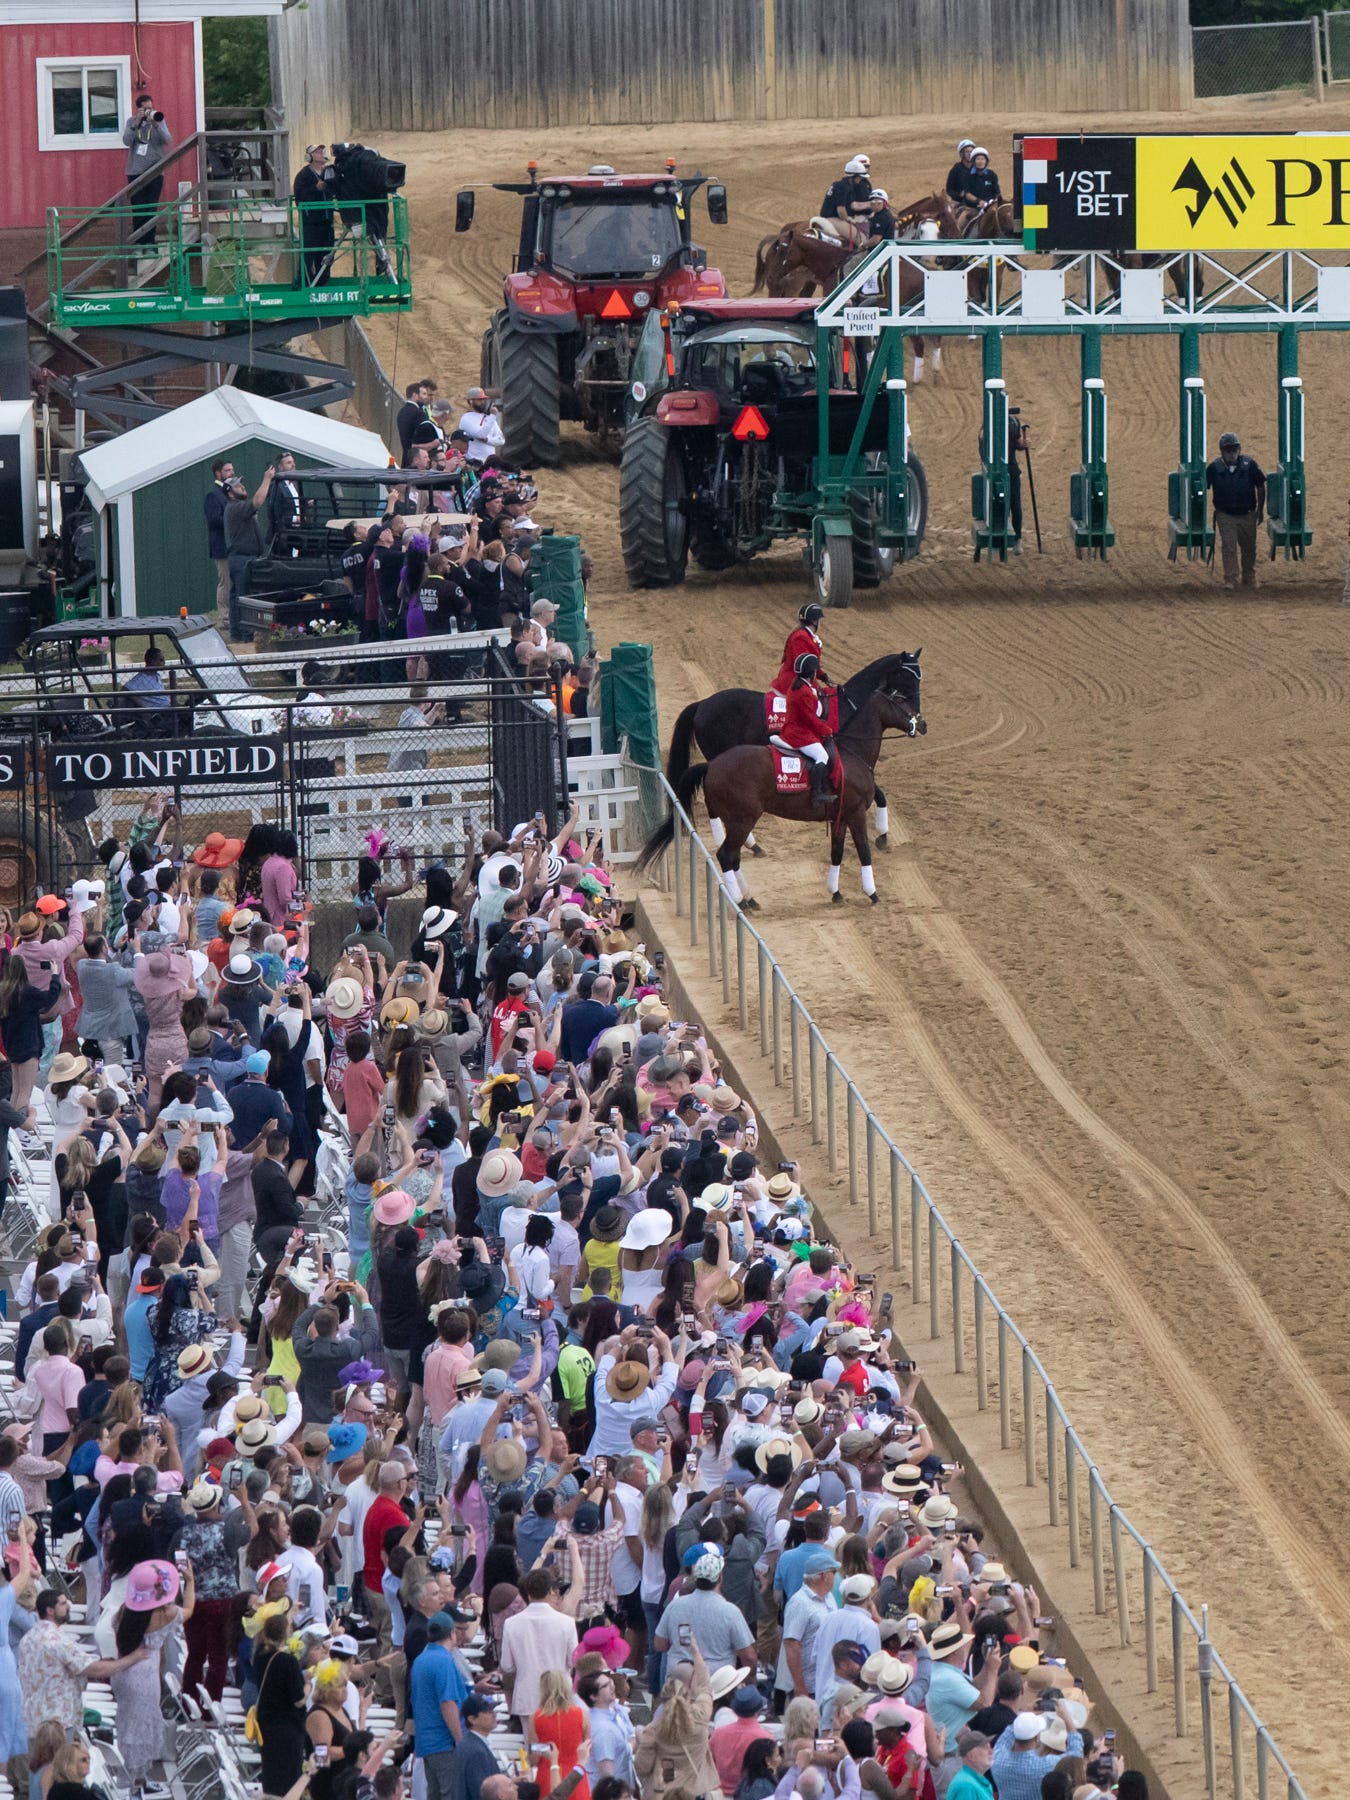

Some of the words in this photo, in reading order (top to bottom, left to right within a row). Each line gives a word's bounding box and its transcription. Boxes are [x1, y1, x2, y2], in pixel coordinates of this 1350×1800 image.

[1055, 170, 1112, 194] 1/ST
[1077, 193, 1129, 216] BET
[653, 255, 659, 266] 2
[346, 290, 360, 302] RT
[63, 302, 111, 313] SKYJACK
[846, 311, 877, 321] United
[850, 323, 874, 332] Puett
[420, 588, 437, 596] APEX
[55, 753, 112, 782] TO
[121, 745, 277, 779] INFIELD
